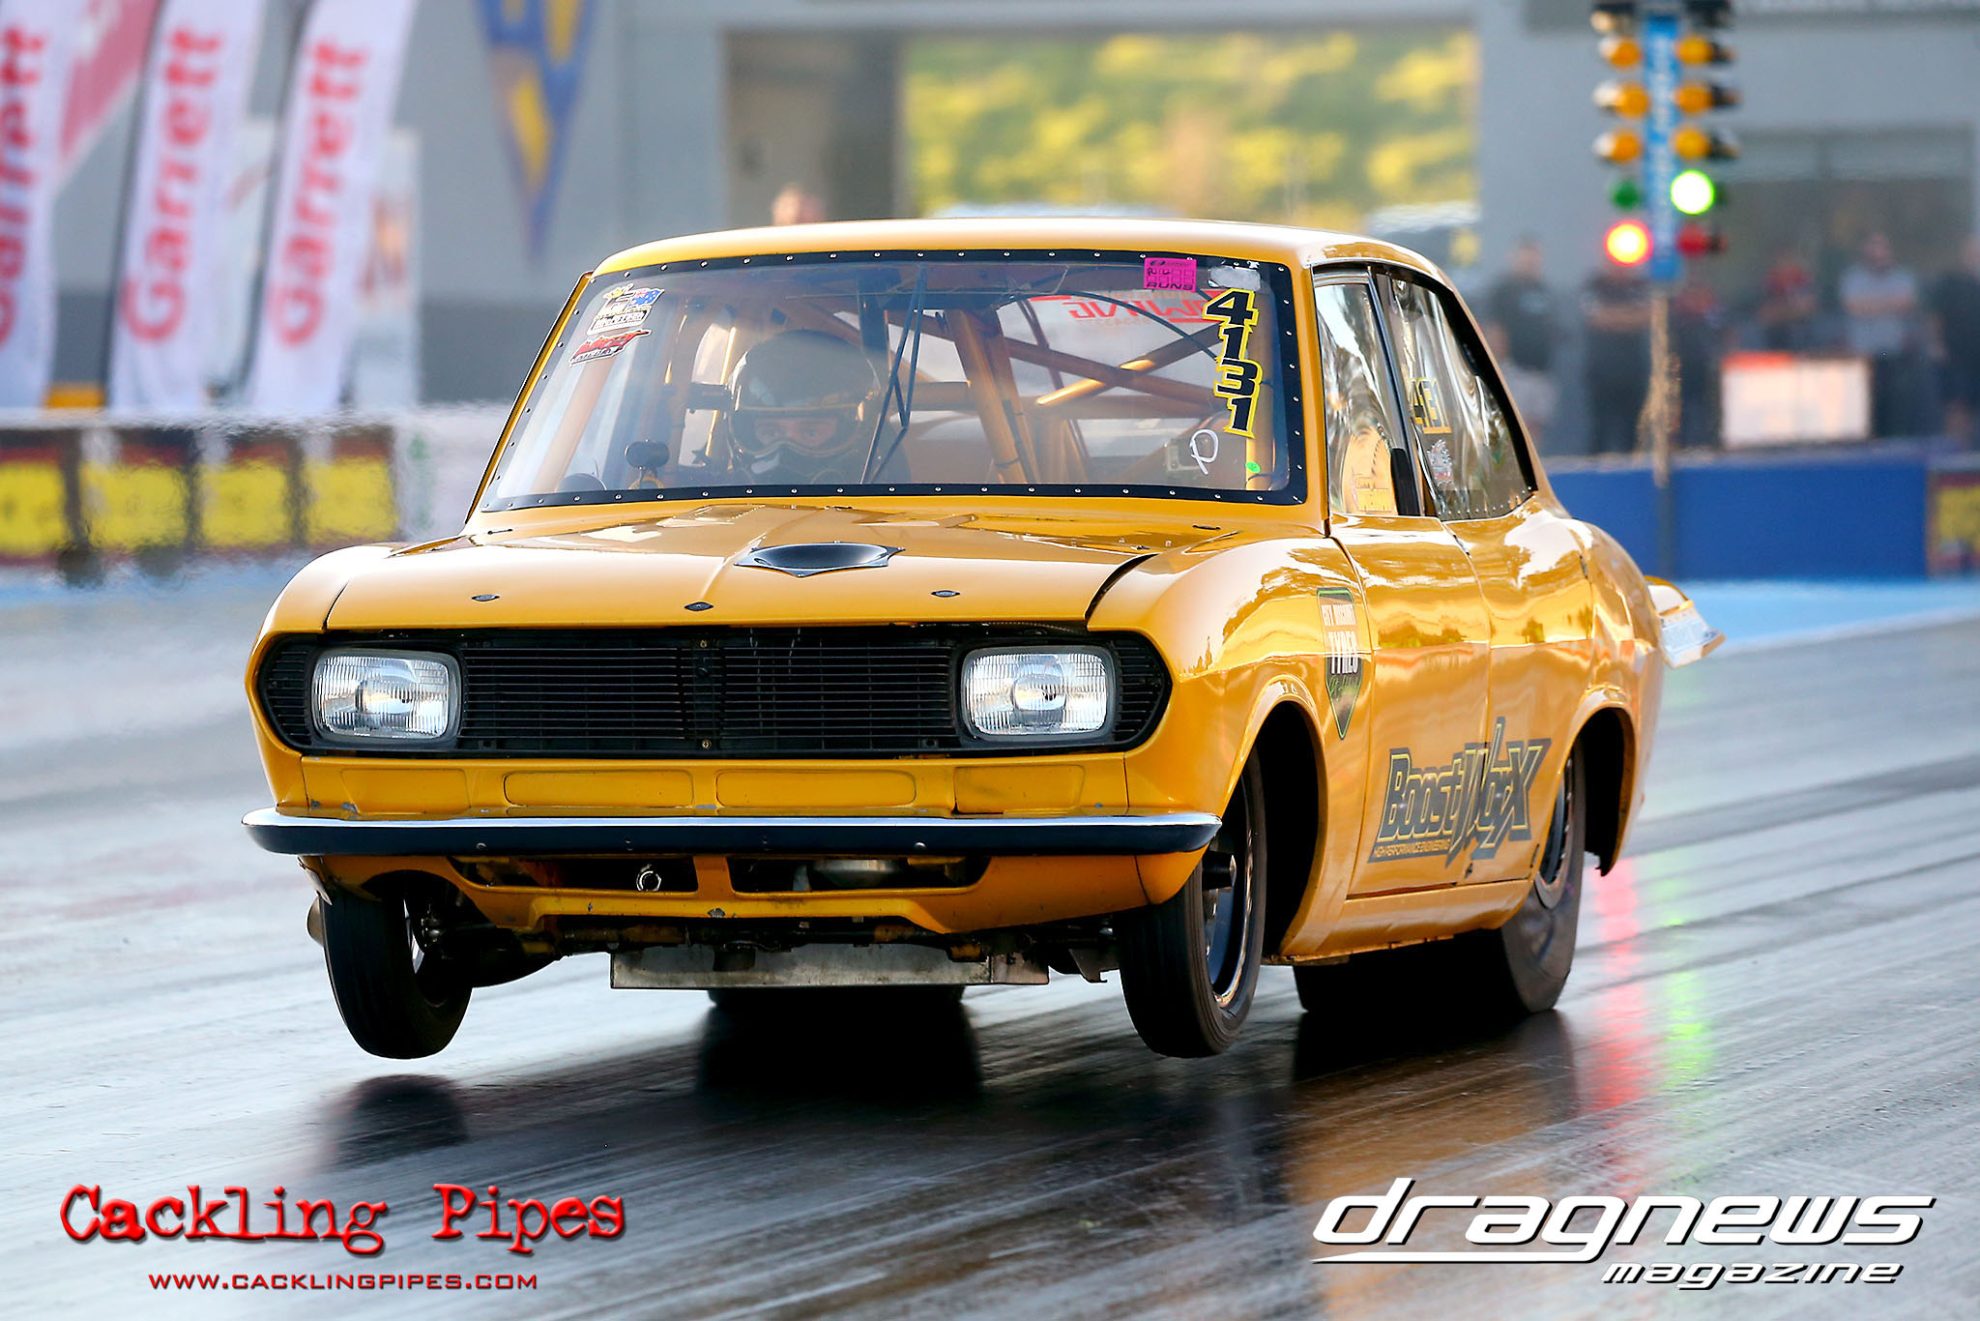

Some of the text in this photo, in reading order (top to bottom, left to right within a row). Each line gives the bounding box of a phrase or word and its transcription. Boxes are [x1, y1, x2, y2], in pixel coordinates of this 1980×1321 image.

[121, 27, 222, 345] Garrett
[267, 38, 370, 349] Garrett
[1203, 288, 1263, 439] 4131
